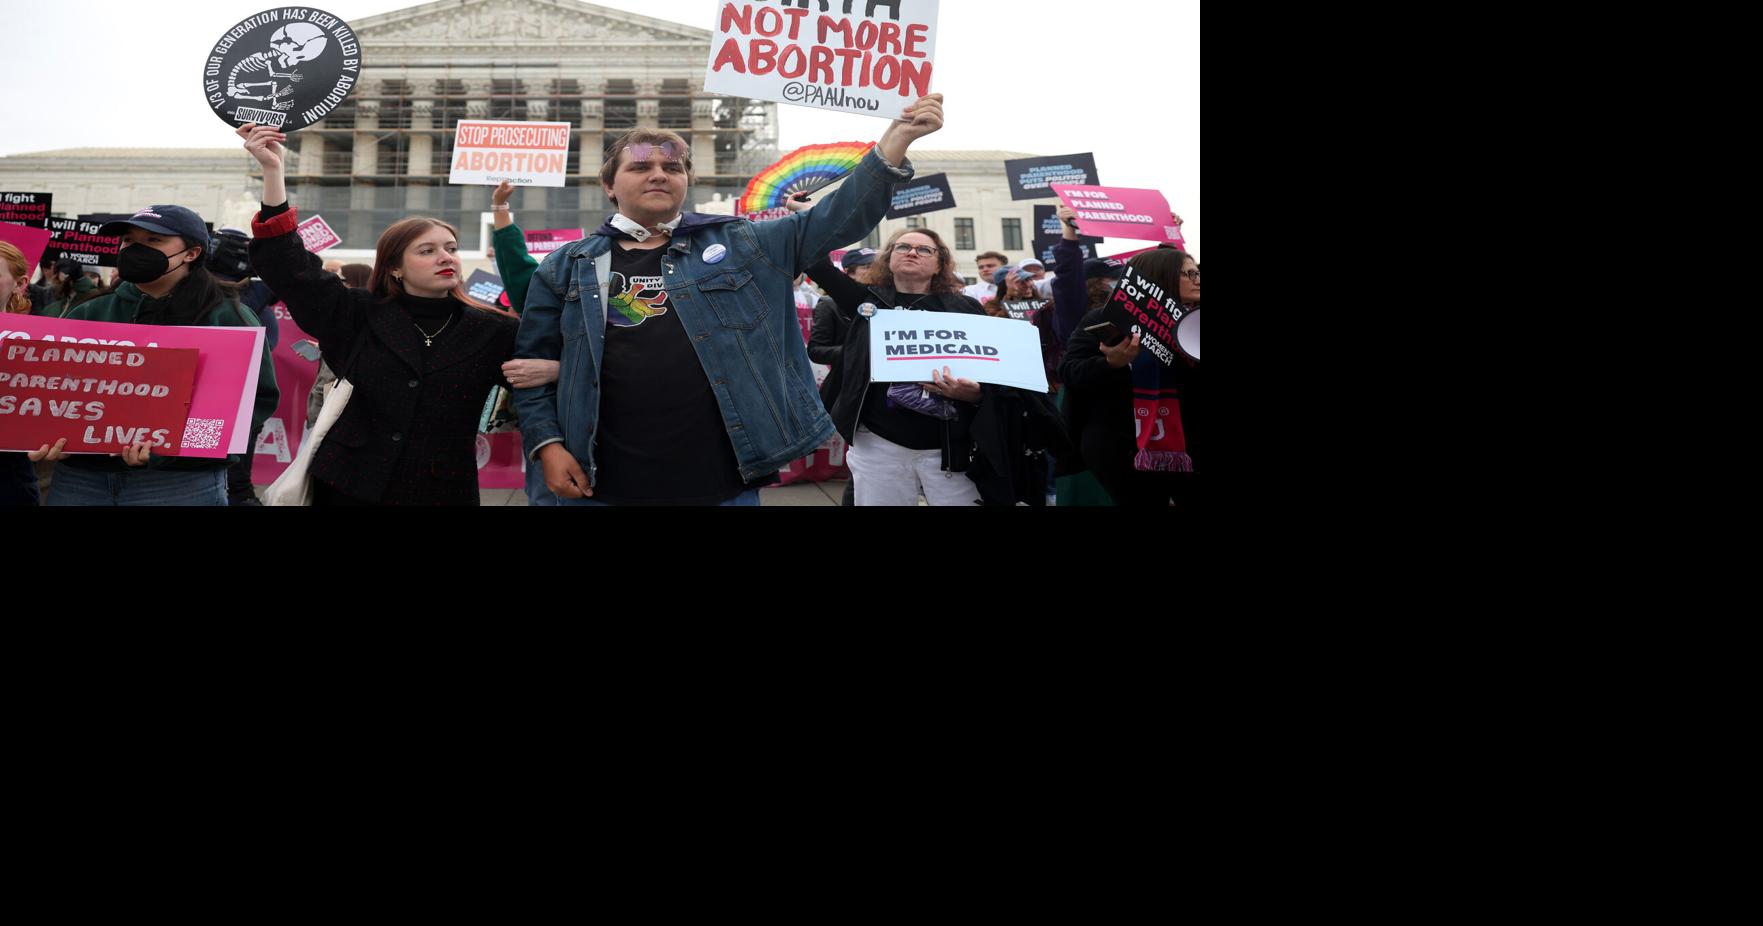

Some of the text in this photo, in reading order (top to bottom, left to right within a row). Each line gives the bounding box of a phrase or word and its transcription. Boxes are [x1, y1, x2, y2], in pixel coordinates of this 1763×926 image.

[282, 8, 308, 20] HAS
[308, 11, 339, 30] BEEN
[215, 10, 278, 54] GENERATION
[332, 25, 358, 56] KILLED
[720, 3, 809, 40] NOT
[817, 15, 929, 58] MORE
[206, 56, 223, 76] OUR
[342, 59, 358, 72] BY
[712, 37, 933, 98] ABORTION
[206, 80, 219, 92] OF
[783, 81, 879, 111] @PAAUnow
[302, 75, 354, 124] ABORTION!
[236, 107, 285, 126] SURVIVORS
[459, 126, 567, 146] STOP PROSECUTING
[455, 151, 564, 173] ABORTION
[5, 193, 35, 204] fight
[1071, 200, 1124, 210] PLANNED
[1084, 191, 1108, 199] FOR
[52, 220, 76, 231] will
[1077, 211, 1153, 223] PARENTHOOD
[64, 230, 120, 245] Planned
[48, 241, 119, 255] arenthood
[1120, 278, 1145, 301] for
[1125, 266, 1133, 278] I
[1136, 275, 1164, 301] will
[884, 330, 968, 341] I'M FOR
[8, 345, 145, 367] PLANNED
[886, 344, 998, 356] MEDICAID
[1141, 338, 1172, 366] MARCH
[0, 372, 170, 398] PARENTHOOD
[0, 395, 105, 421] SAVES
[83, 425, 171, 449] LIVES.
